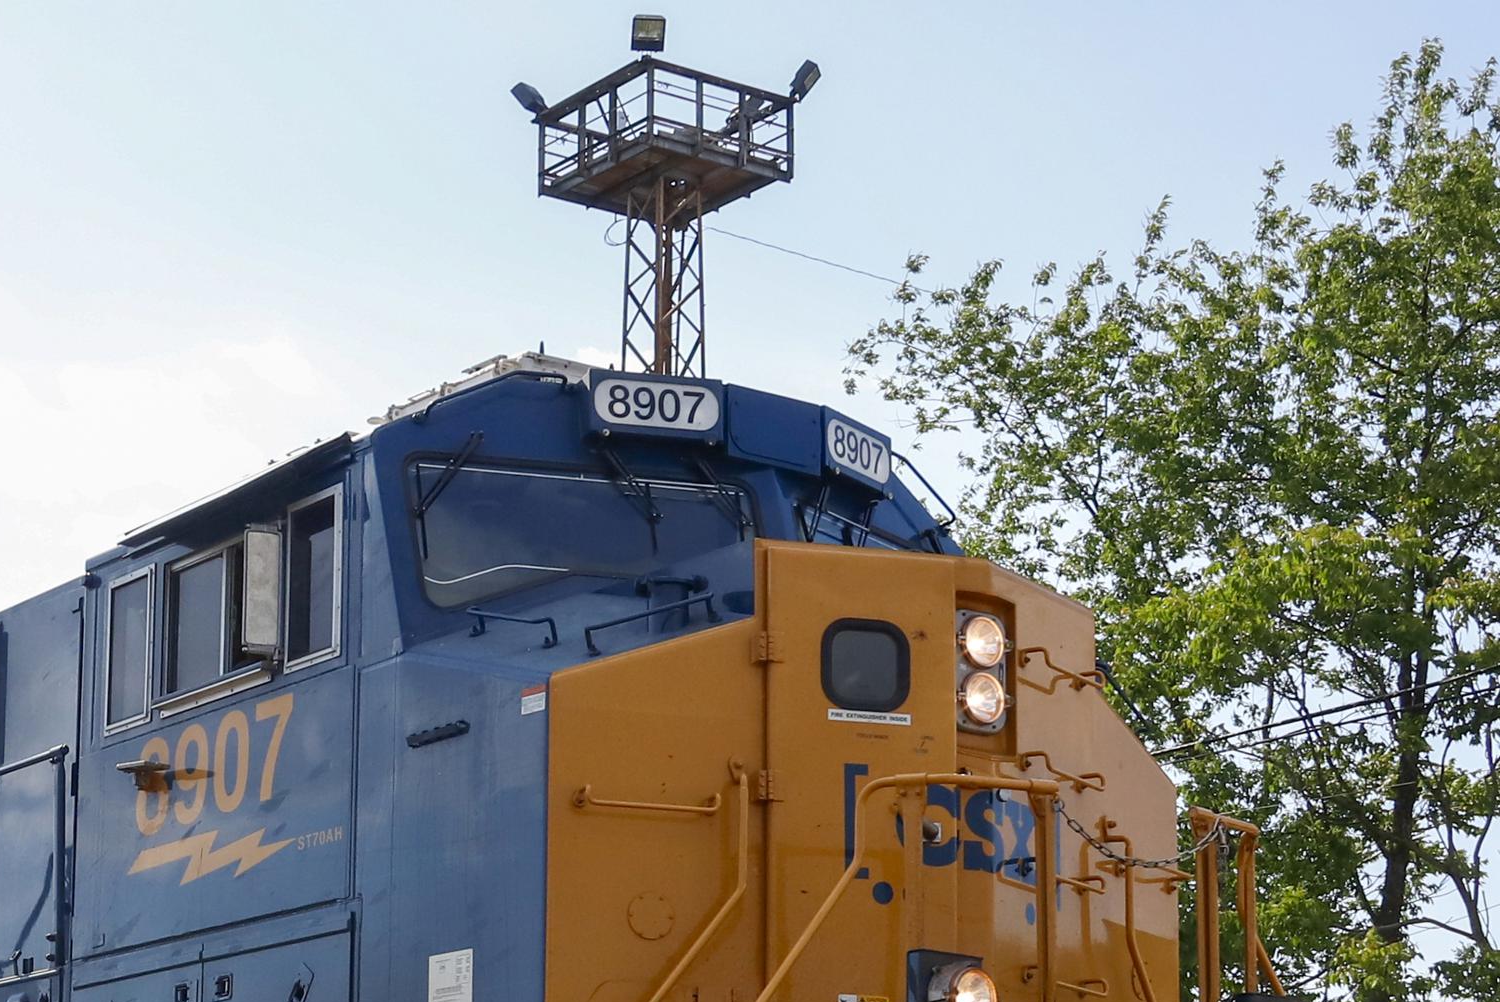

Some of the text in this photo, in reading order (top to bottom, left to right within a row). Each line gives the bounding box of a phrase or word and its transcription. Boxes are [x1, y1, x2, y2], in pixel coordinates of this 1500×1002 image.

[607, 384, 706, 424] 8907
[833, 424, 884, 475] 8907
[845, 712, 887, 721] EXTINGUISHER
[888, 715, 908, 723] INSIDE
[135, 693, 294, 837] 8907
[297, 825, 343, 851] ST70AH
